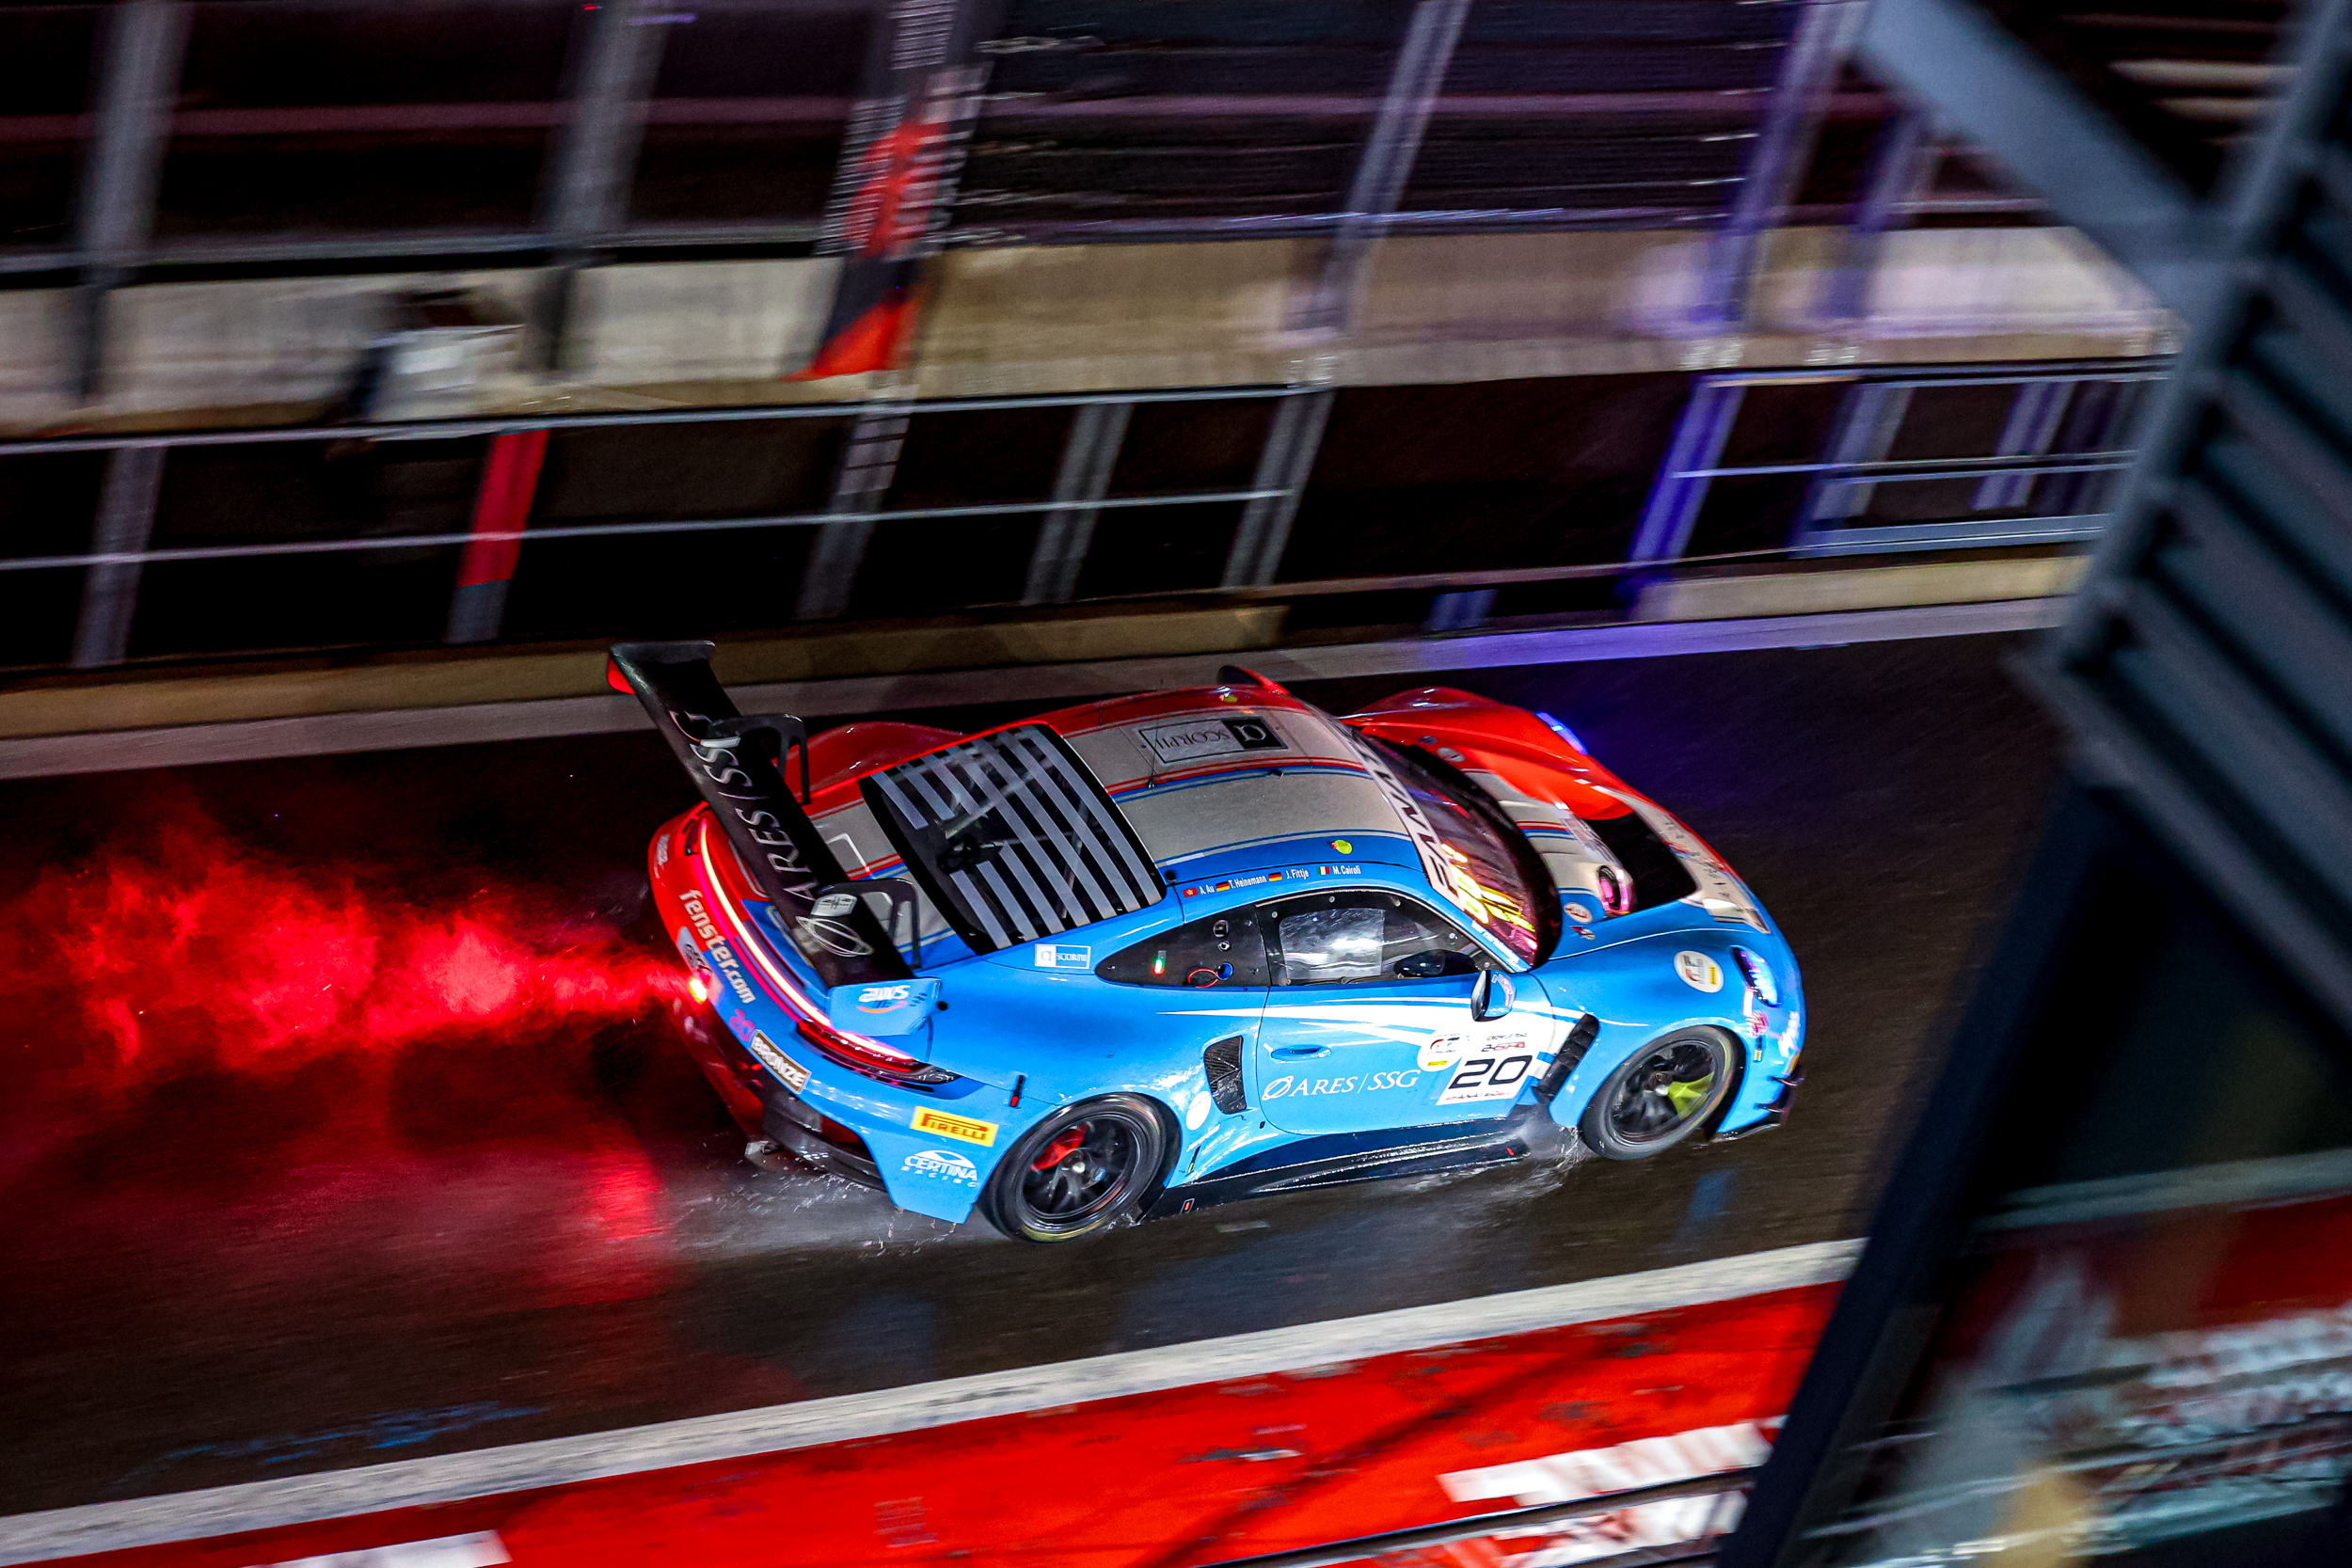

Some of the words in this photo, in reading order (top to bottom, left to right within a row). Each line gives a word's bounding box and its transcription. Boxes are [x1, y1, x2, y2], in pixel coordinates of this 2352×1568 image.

[679, 889, 755, 1004] fenster.com
[751, 1036, 806, 1087] BRONZE
[1448, 1054, 1533, 1089] 20
[921, 1114, 989, 1141] PIRELLI
[904, 1155, 977, 1181] CERTINA
